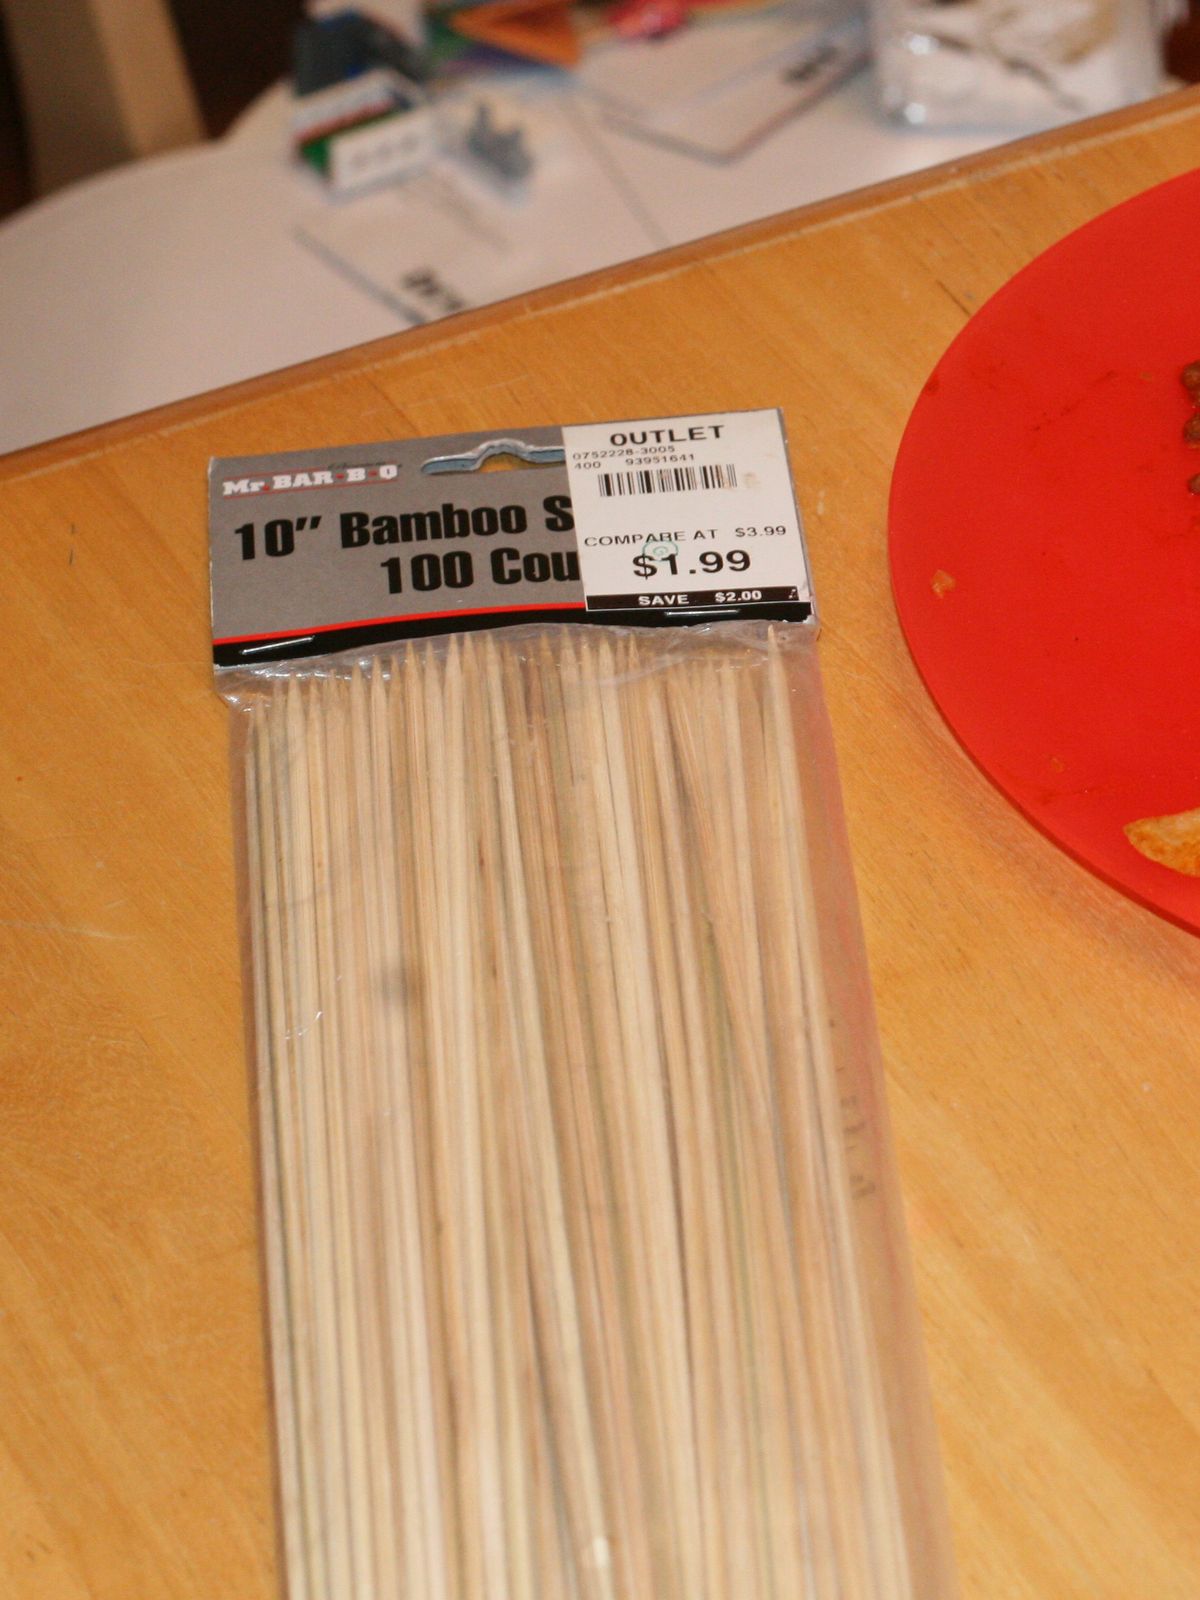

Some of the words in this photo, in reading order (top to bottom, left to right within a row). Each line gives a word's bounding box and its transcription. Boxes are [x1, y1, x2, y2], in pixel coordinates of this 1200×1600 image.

[609, 424, 725, 447] OUTLET
[572, 445, 676, 461] 0752228-3005
[574, 461, 602, 470] 400
[625, 453, 695, 466] 93951641
[234, 515, 322, 561] 10"
[339, 502, 528, 549] Bamboo
[543, 495, 575, 532] S
[584, 530, 686, 547] COMPARE
[693, 528, 719, 541] AT
[735, 525, 787, 538] $3.99
[380, 551, 474, 594] 100
[490, 547, 580, 585] Cou
[632, 549, 751, 580] $1.99
[638, 594, 690, 607] SAVE
[715, 589, 763, 603] $2.00
